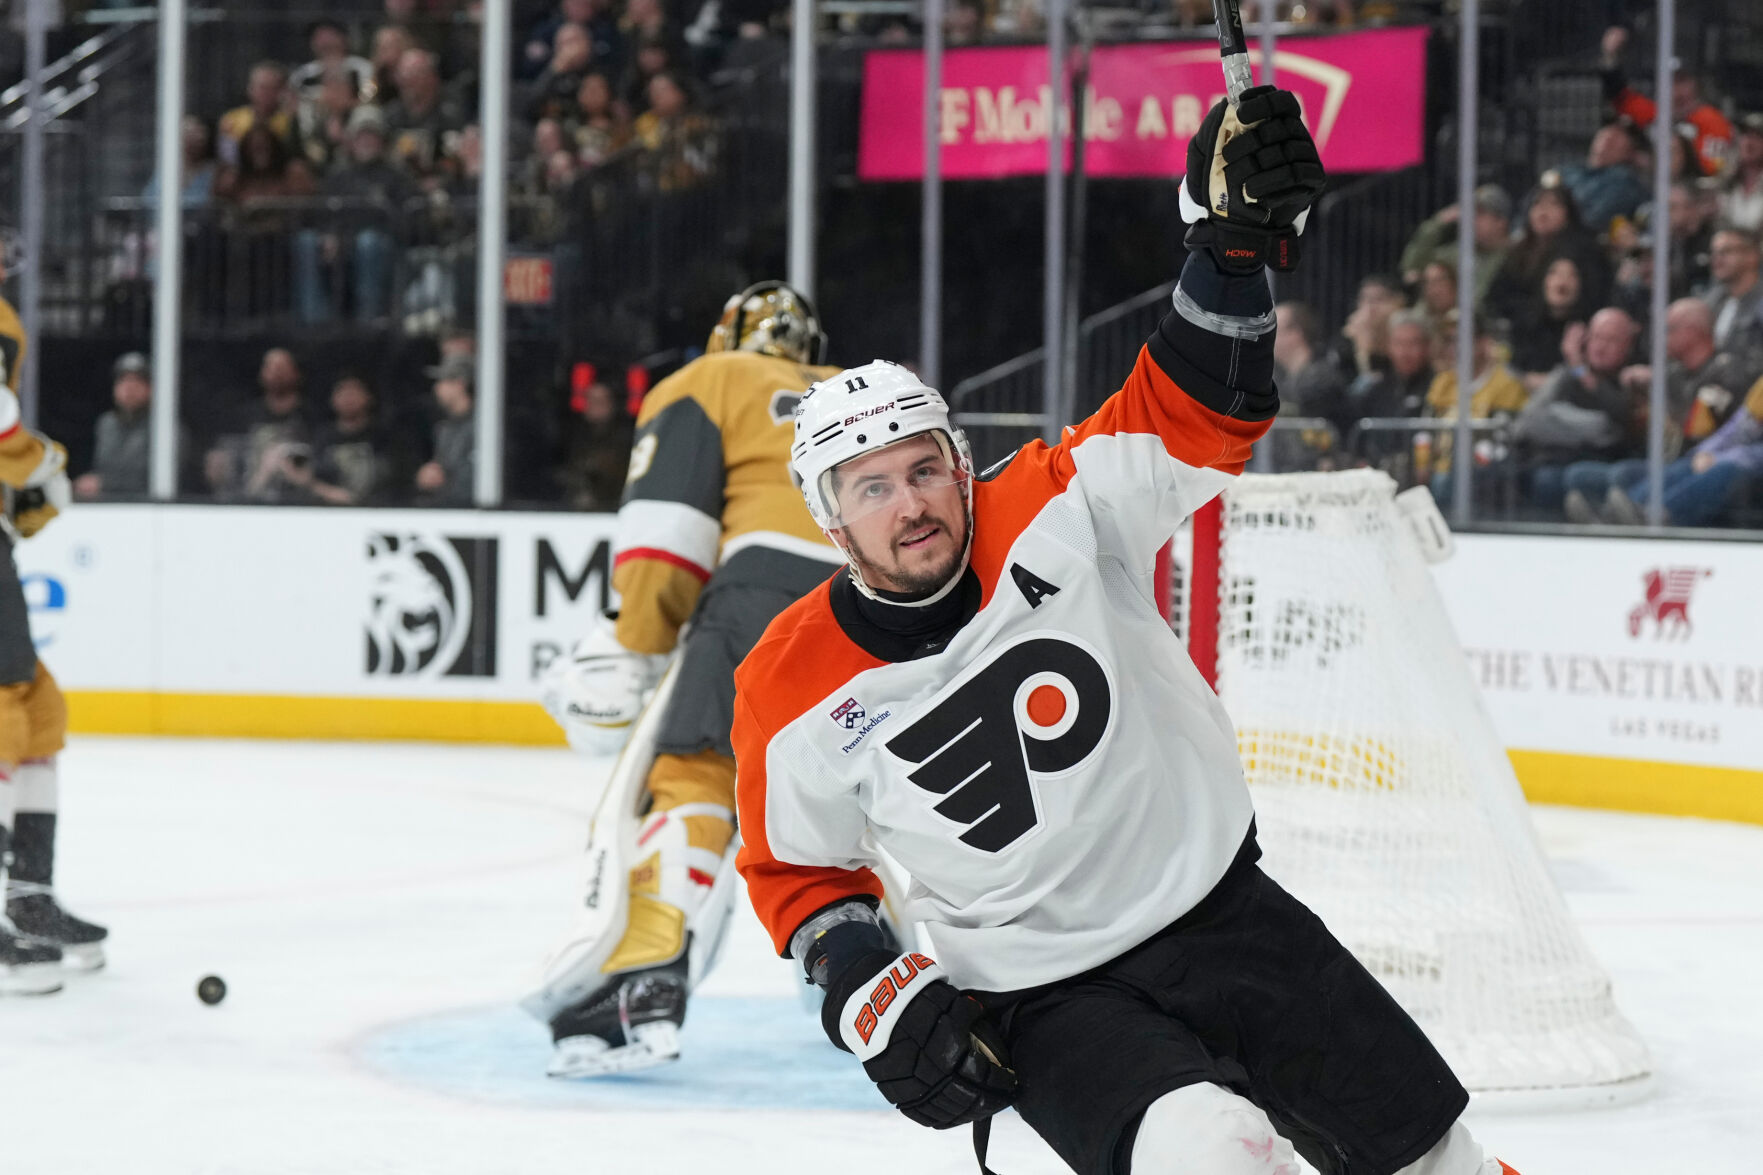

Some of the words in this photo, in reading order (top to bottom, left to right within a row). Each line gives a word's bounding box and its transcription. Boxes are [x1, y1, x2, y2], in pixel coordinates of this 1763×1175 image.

[845, 376, 869, 394] 11
[844, 401, 896, 427] BAUER
[1010, 562, 1061, 609] A
[1541, 652, 1724, 703] VENETIAN
[842, 736, 862, 754] Penn
[859, 710, 891, 737] Medicine
[1611, 717, 1648, 738] LAS
[1656, 720, 1720, 744] VEGAS
[854, 952, 937, 1046] BAUE
